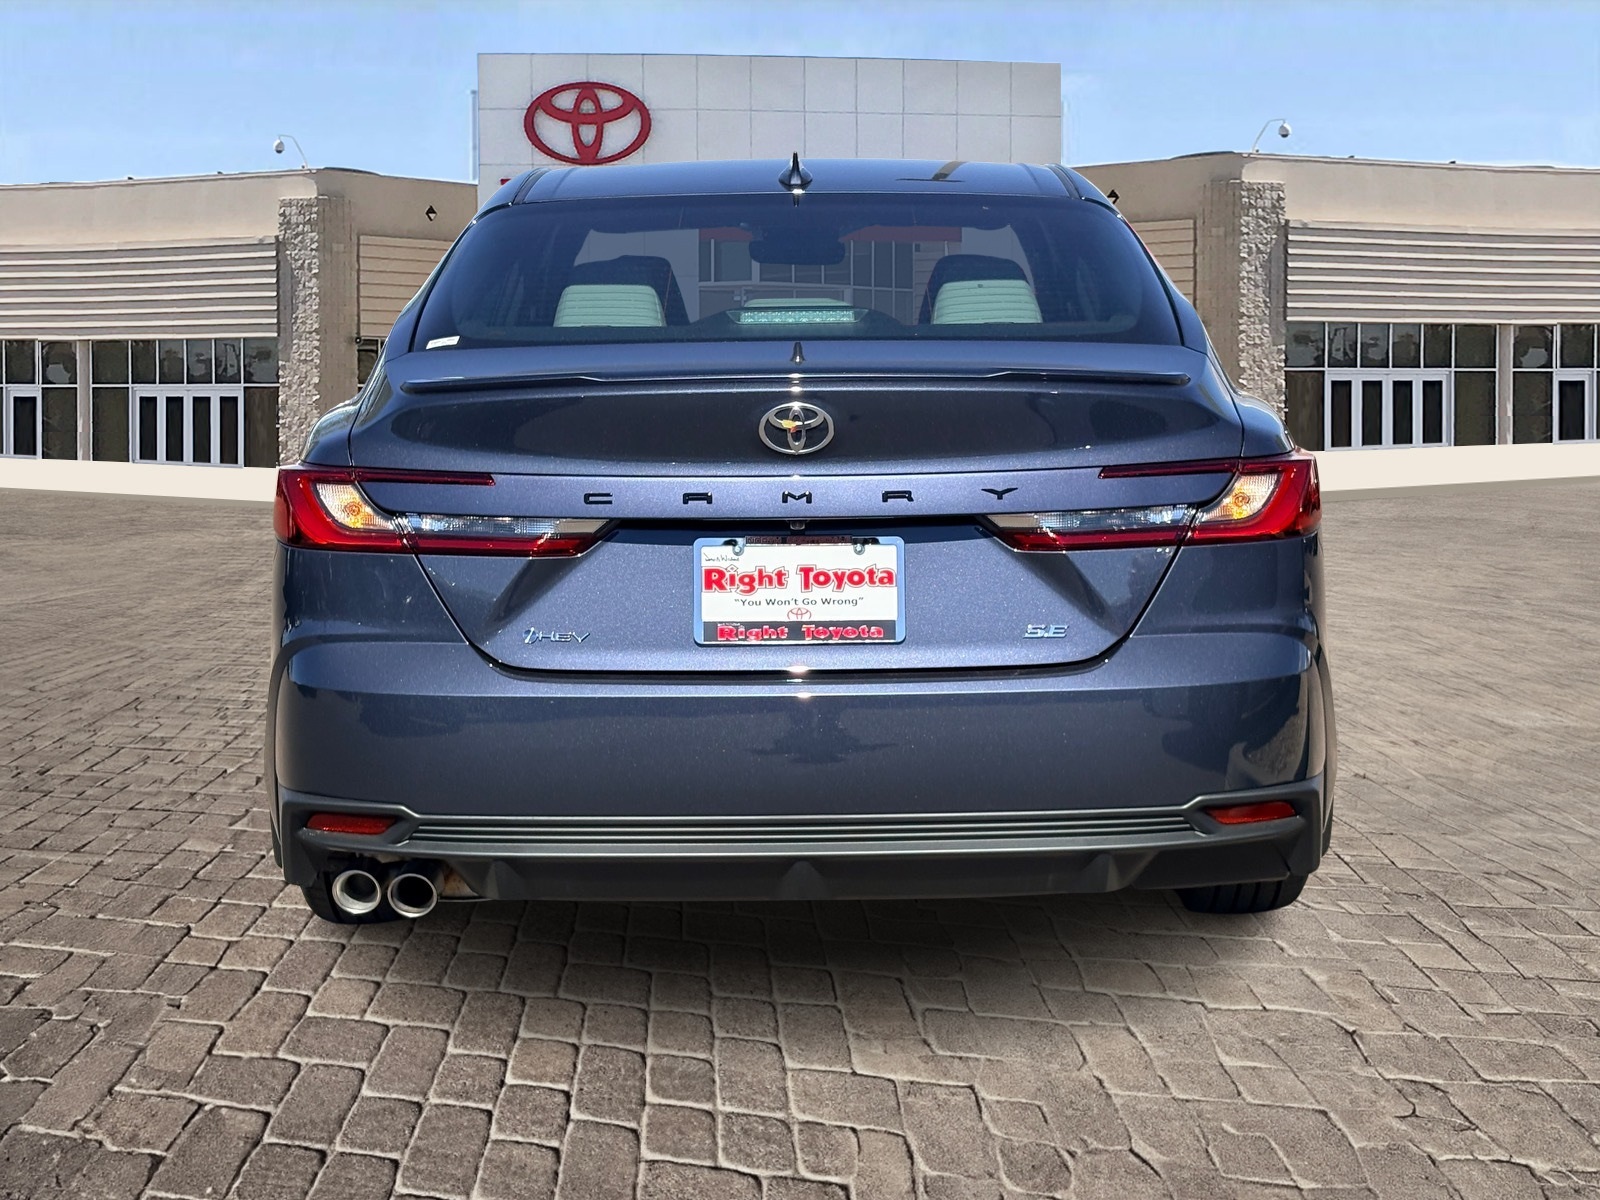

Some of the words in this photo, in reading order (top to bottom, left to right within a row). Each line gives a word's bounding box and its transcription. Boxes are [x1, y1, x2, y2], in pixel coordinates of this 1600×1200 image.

[583, 487, 1019, 505] CAMRY
[703, 566, 788, 595] Right
[797, 564, 897, 592] Toyota
[765, 597, 799, 606] Won't
[802, 597, 817, 606] Go
[717, 625, 788, 641] Right
[801, 624, 884, 641] Toyota
[1023, 623, 1069, 639] SE
